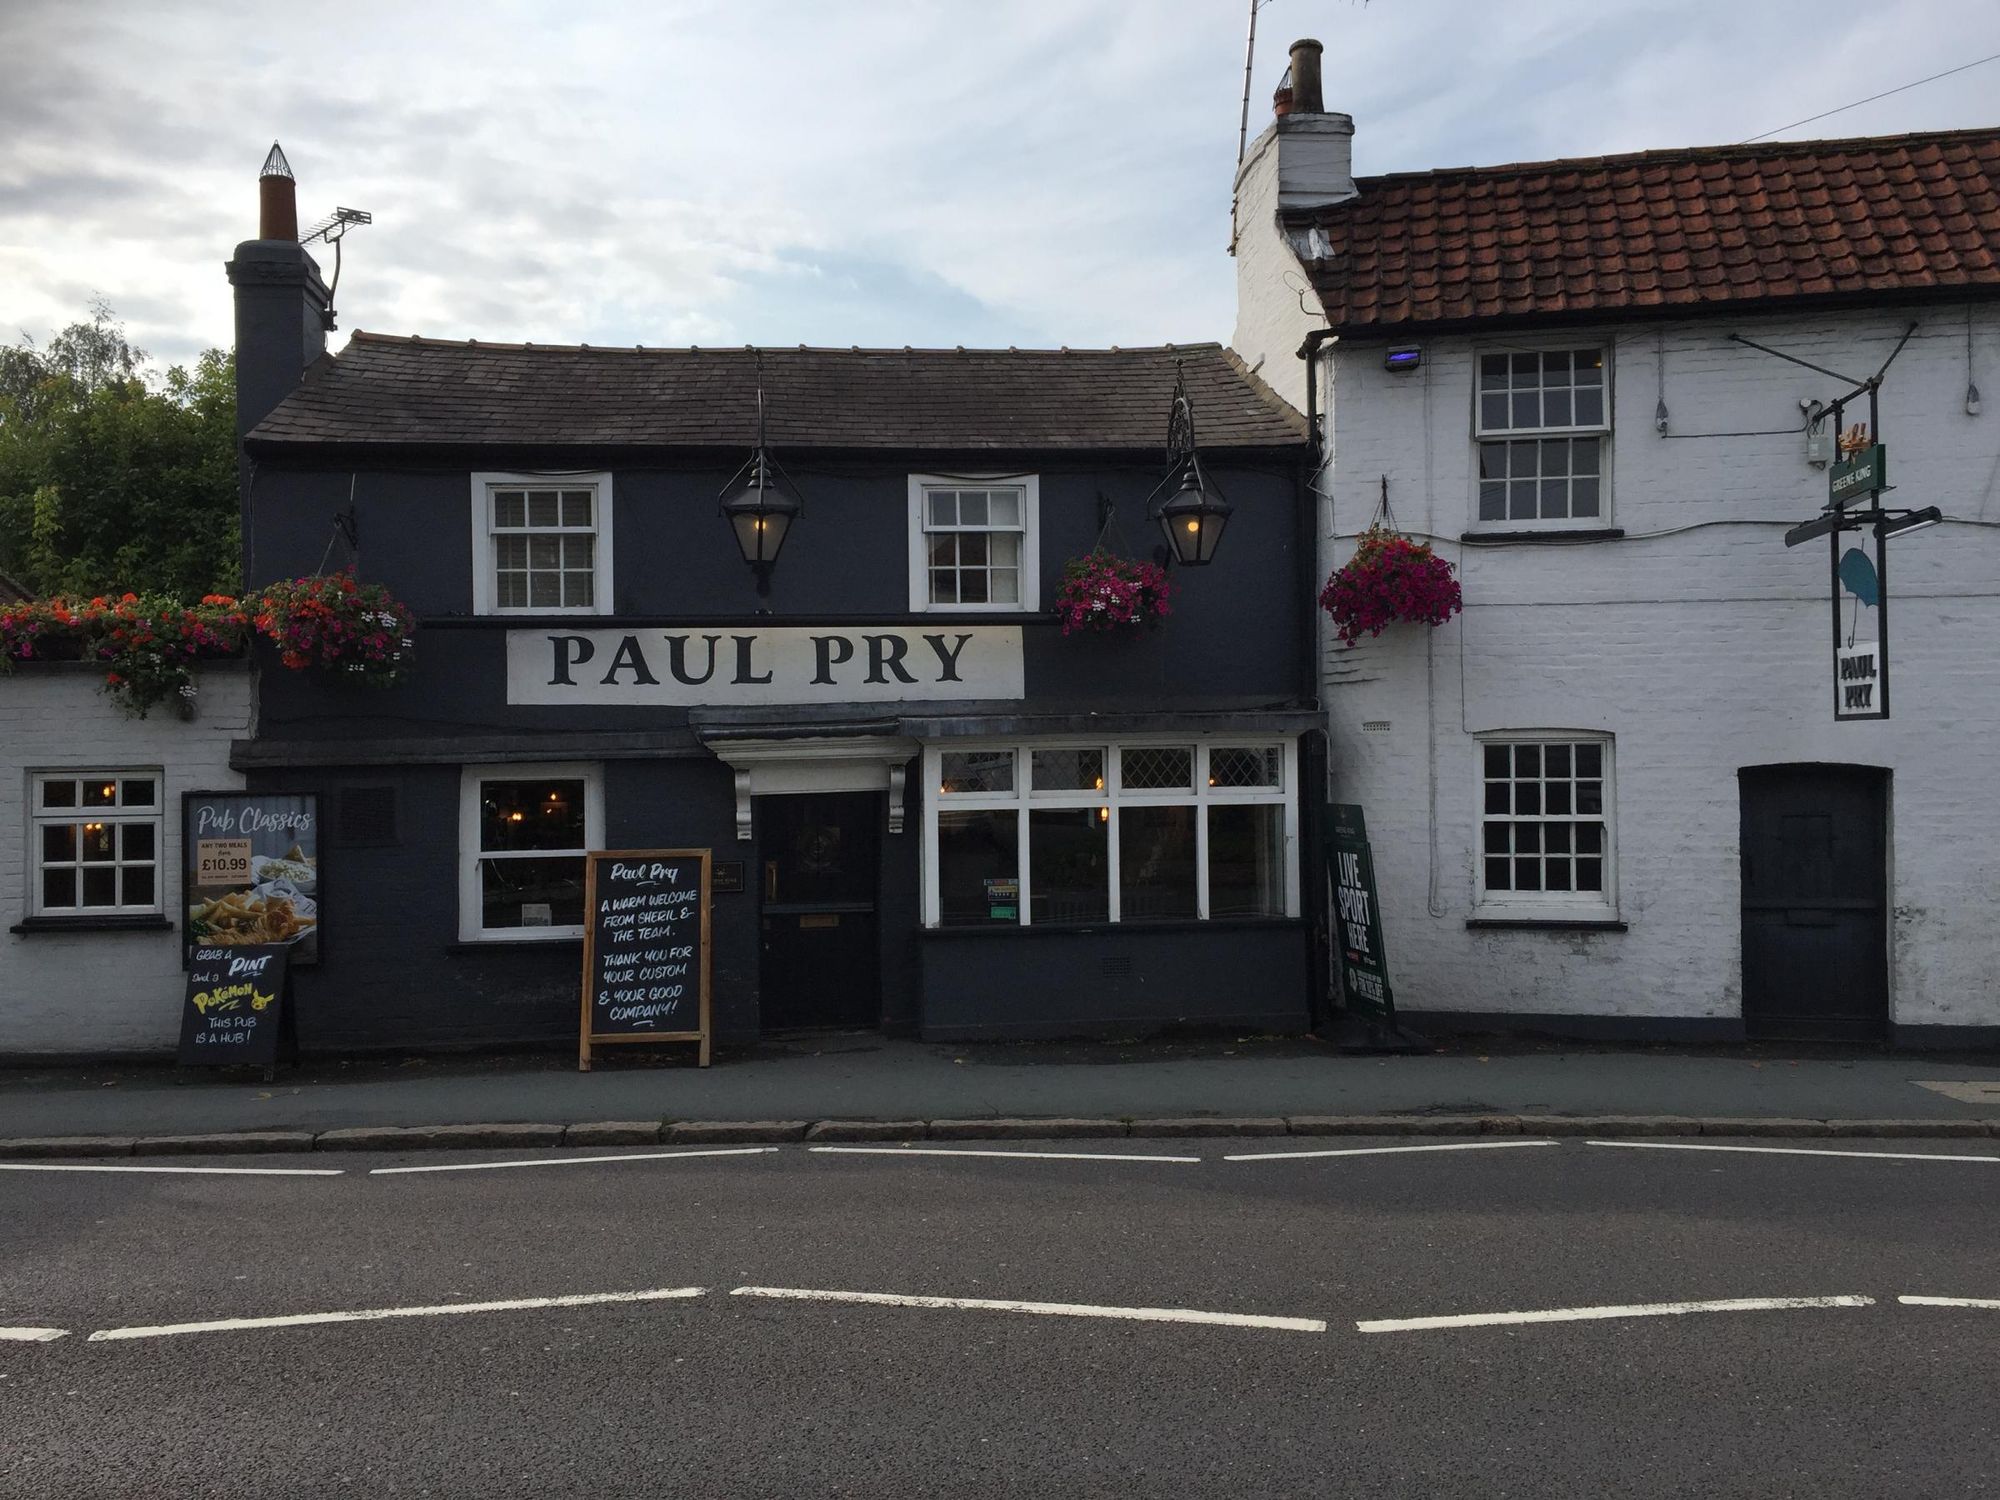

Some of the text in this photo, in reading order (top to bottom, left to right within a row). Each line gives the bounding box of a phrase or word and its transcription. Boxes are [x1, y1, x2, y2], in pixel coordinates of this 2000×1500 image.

[1832, 465, 1871, 492] GREENE KING
[547, 633, 974, 686] PAUL PRY
[1840, 654, 1877, 681] PAUL
[1844, 683, 1873, 709] PRY
[197, 806, 312, 834] Pub Classics
[202, 858, 247, 871] £10.99
[611, 863, 679, 884] Paul Pry
[1338, 852, 1361, 889] LIVE
[601, 889, 697, 913] A WARM WELCOME
[1338, 886, 1370, 925] SPORT
[603, 907, 695, 928] FROM SHERIL &
[612, 930, 635, 943] THE
[1347, 922, 1370, 953] HERE
[196, 949, 232, 960] GRAB A
[603, 946, 693, 967] THANK YOU FOR
[228, 955, 273, 976] PINT
[603, 963, 687, 984] YOUR CUSTOM
[598, 984, 683, 1005] & YOUR GOOD
[610, 1001, 678, 1021] COMPANY!
[208, 1016, 256, 1028] THIS PUB
[195, 1032, 206, 1044] IS
[209, 1033, 217, 1043] A
